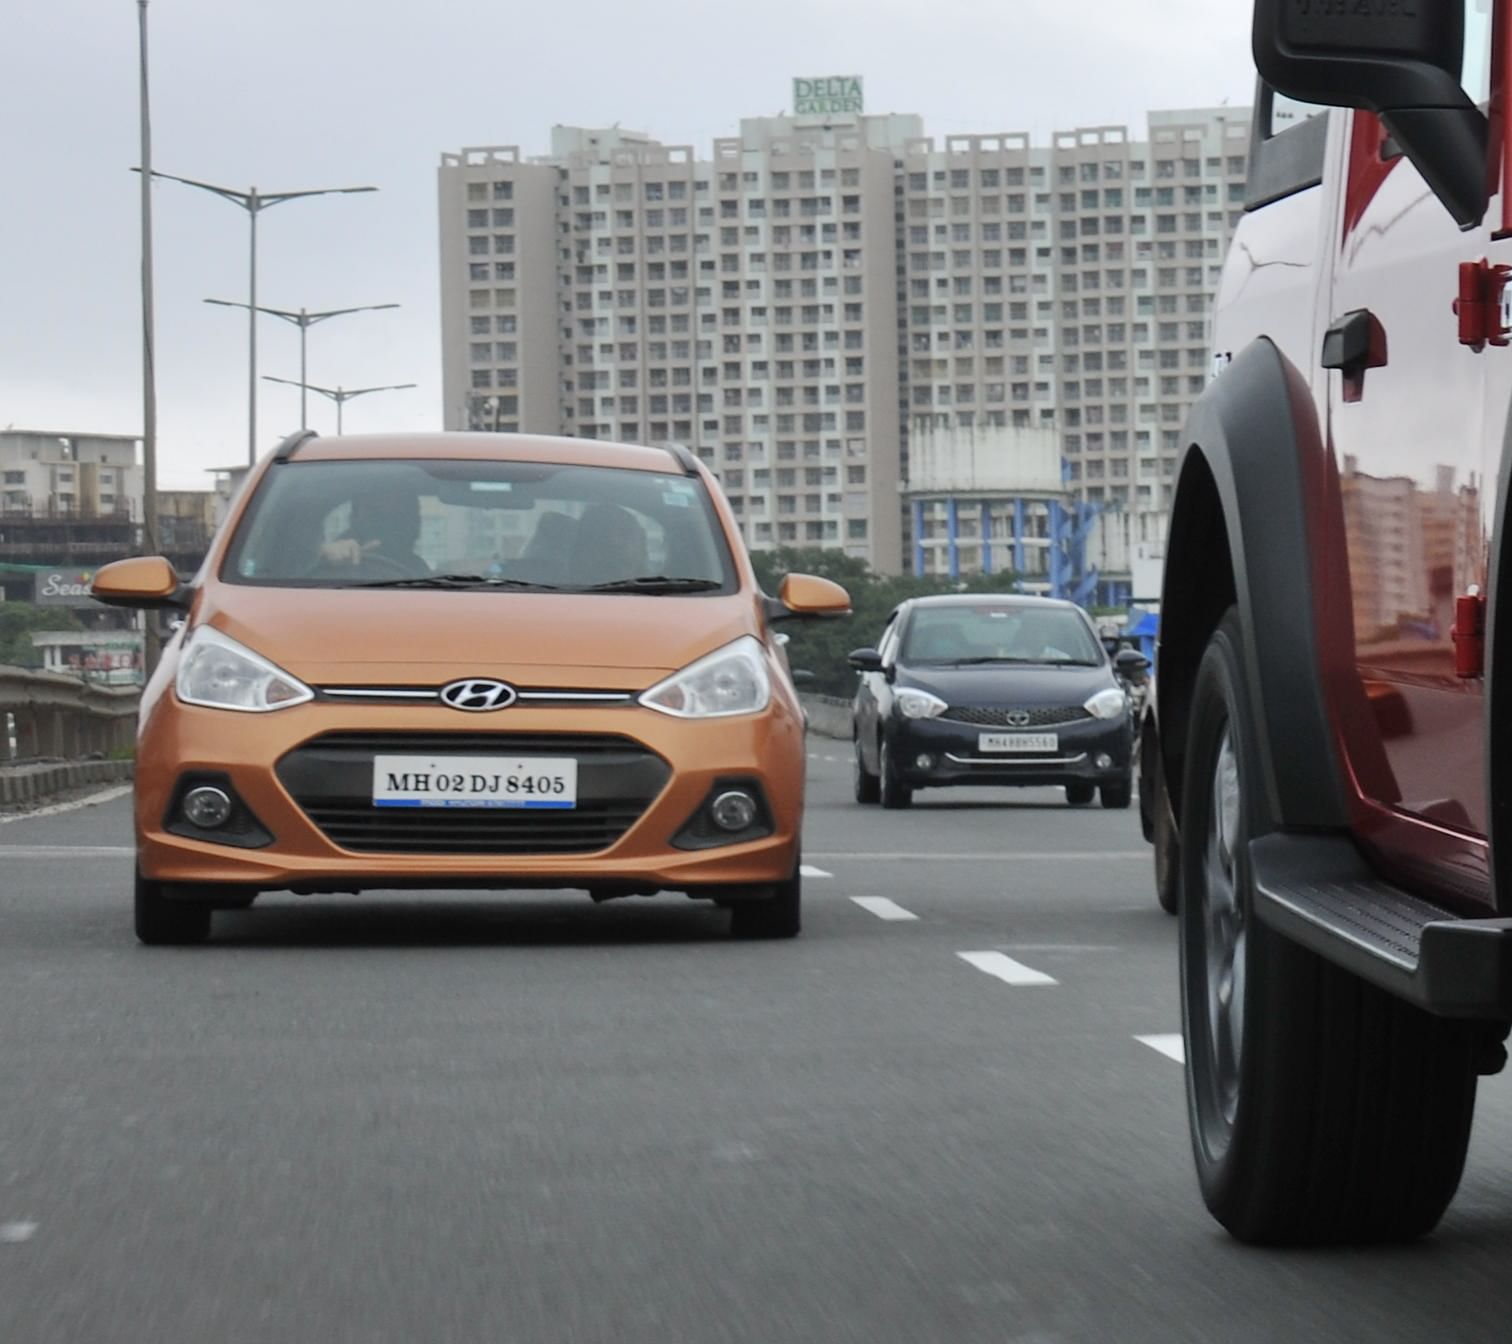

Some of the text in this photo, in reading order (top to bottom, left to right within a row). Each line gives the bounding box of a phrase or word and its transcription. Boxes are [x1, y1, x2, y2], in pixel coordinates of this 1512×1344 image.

[794, 78, 863, 97] DELTA
[794, 98, 863, 114] GARDEN
[386, 773, 565, 794] MH 02 DJ 8405
